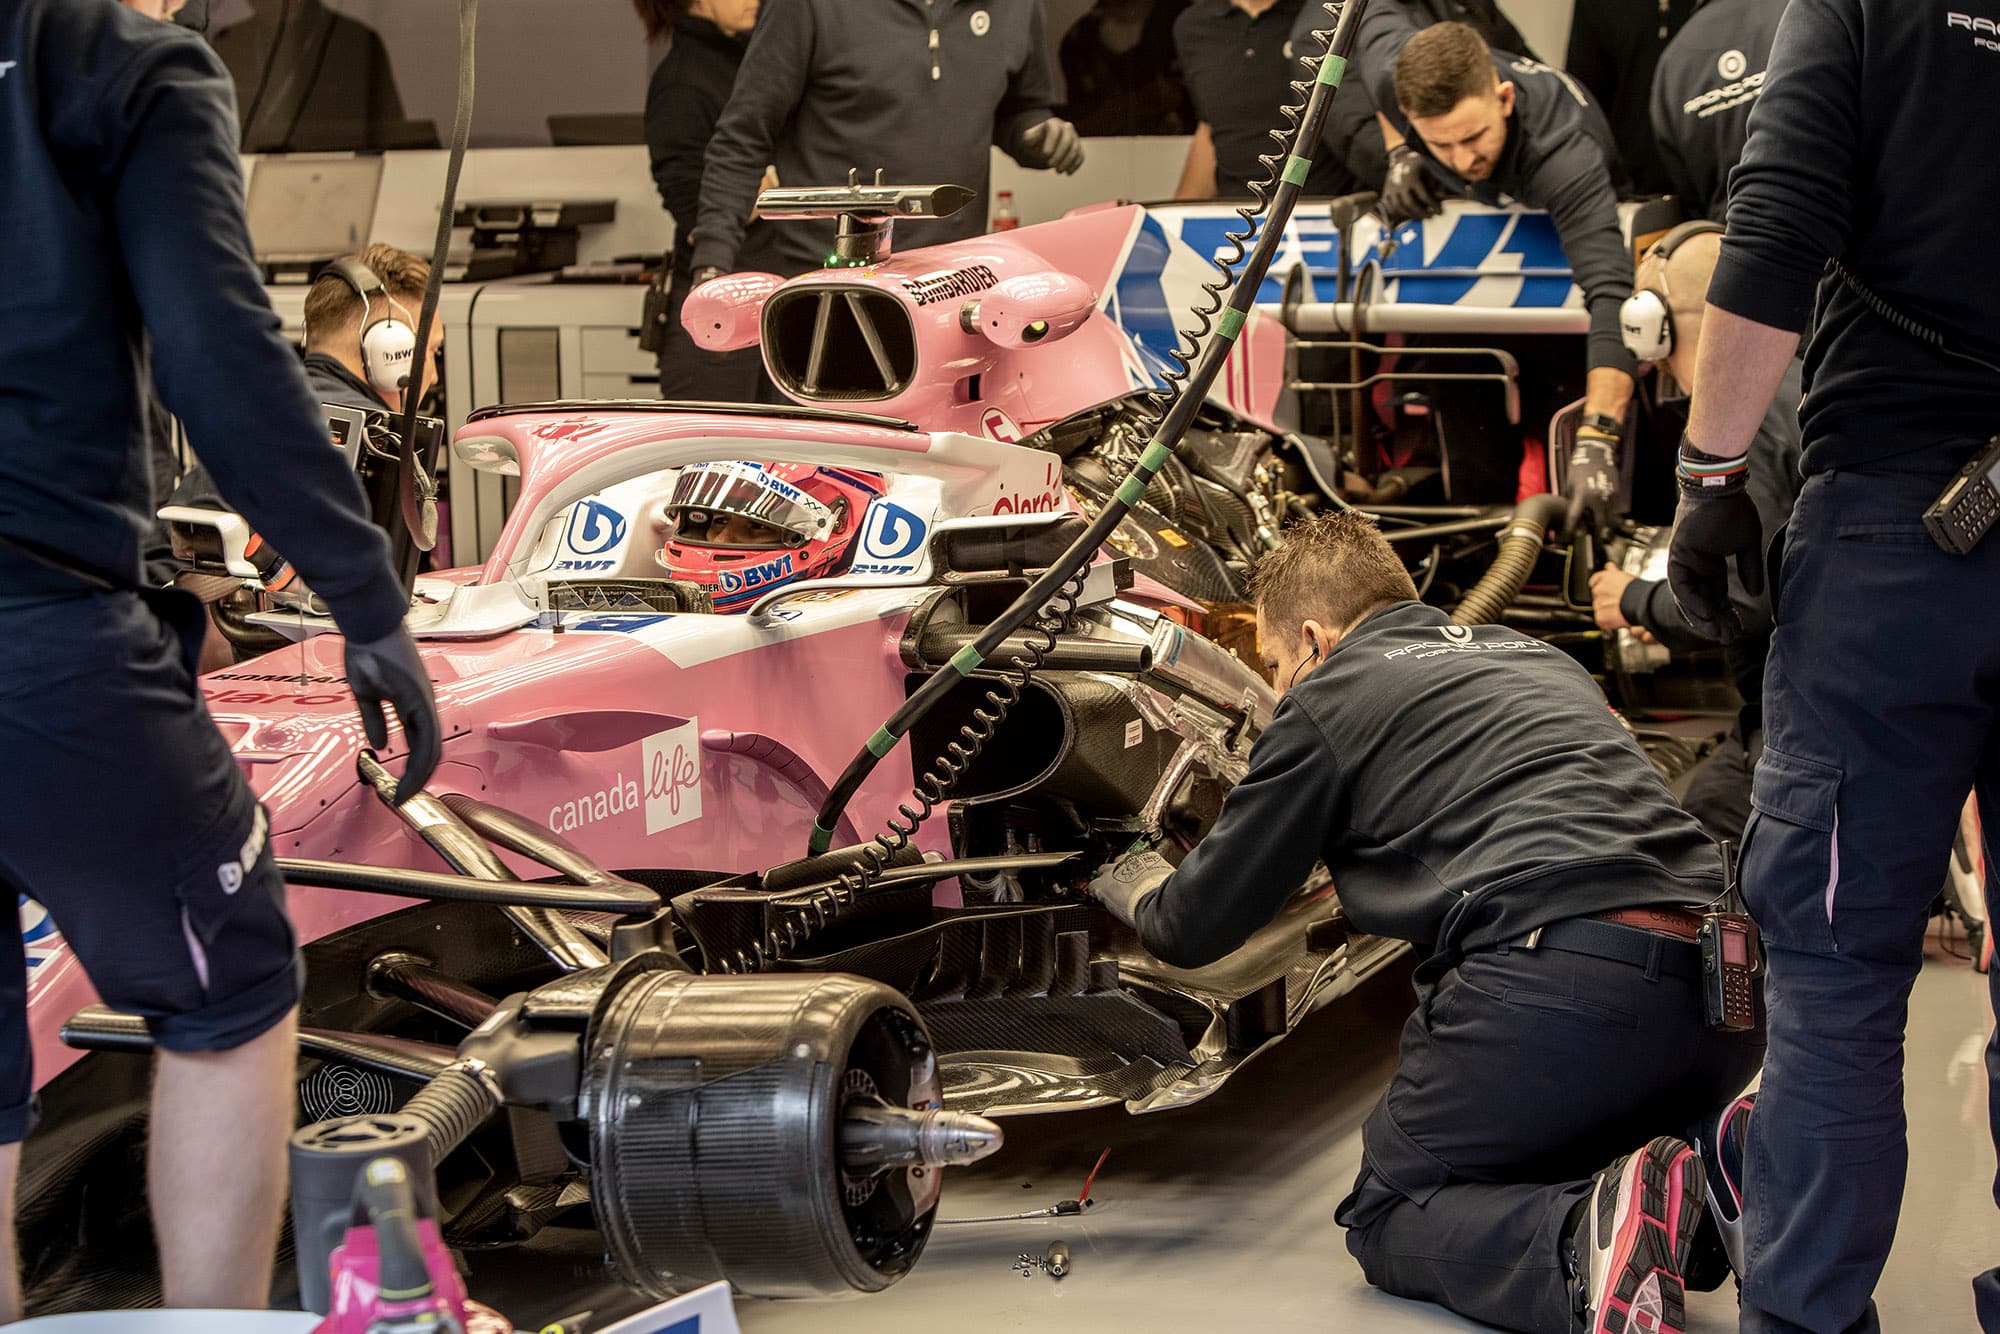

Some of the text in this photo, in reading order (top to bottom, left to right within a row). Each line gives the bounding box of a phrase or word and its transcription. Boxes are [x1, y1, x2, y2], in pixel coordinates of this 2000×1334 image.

[769, 478, 801, 501] BWT
[743, 554, 793, 587] BWT
[549, 743, 702, 835] canada life
